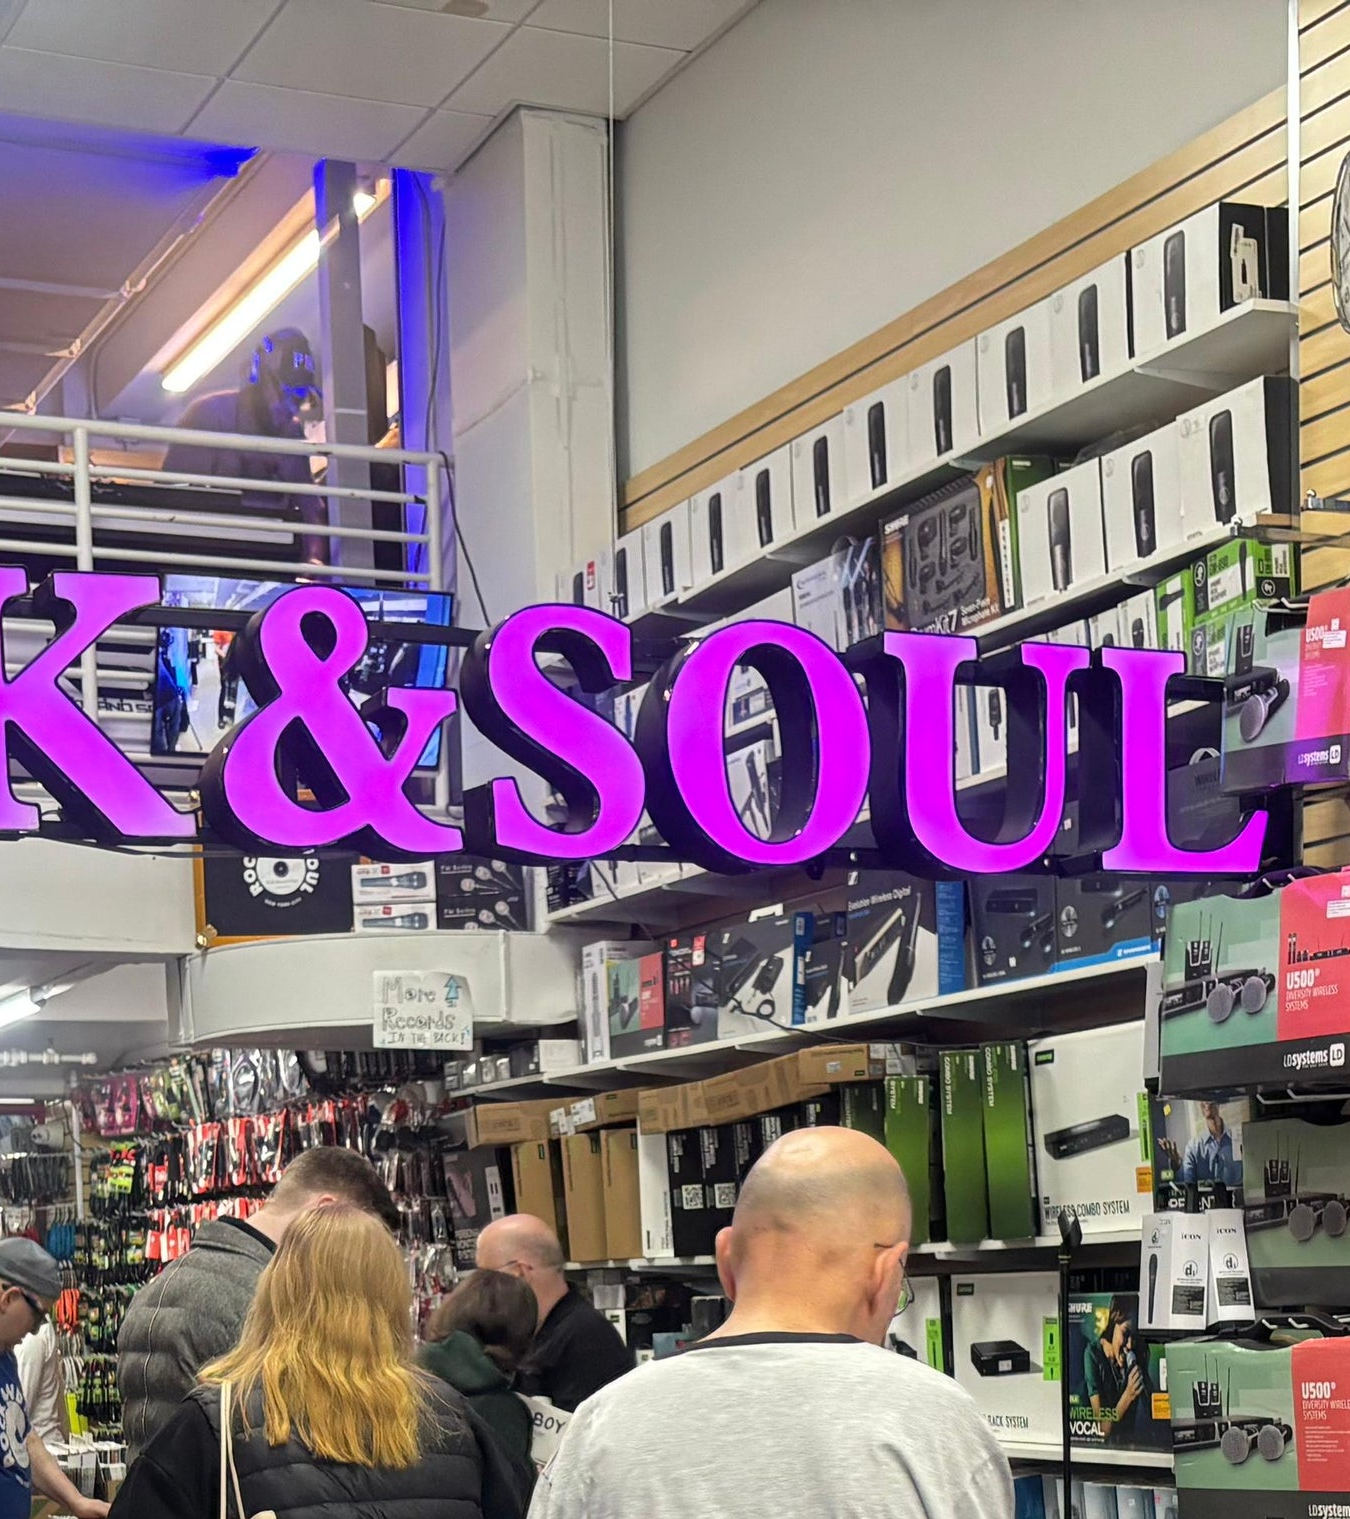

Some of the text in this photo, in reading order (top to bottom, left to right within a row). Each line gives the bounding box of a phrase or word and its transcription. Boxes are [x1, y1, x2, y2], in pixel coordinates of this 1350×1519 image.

[884, 514, 910, 535] SHURE
[223, 586, 463, 853] &
[488, 605, 1268, 873] SOUL
[380, 976, 438, 1006] More
[1285, 984, 1339, 1002] DIVERSITY WIRELESS
[1285, 1000, 1309, 1012] SYSTEMS
[380, 1007, 456, 1033] Records
[387, 1032, 406, 1044] IN
[408, 1030, 428, 1044] THE
[1103, 1200, 1130, 1215] SYSTEM
[1302, 1399, 1328, 1411] DIVERSITY
[1303, 1409, 1327, 1421] SYSTEMS
[1069, 1420, 1105, 1435] VOCAL
